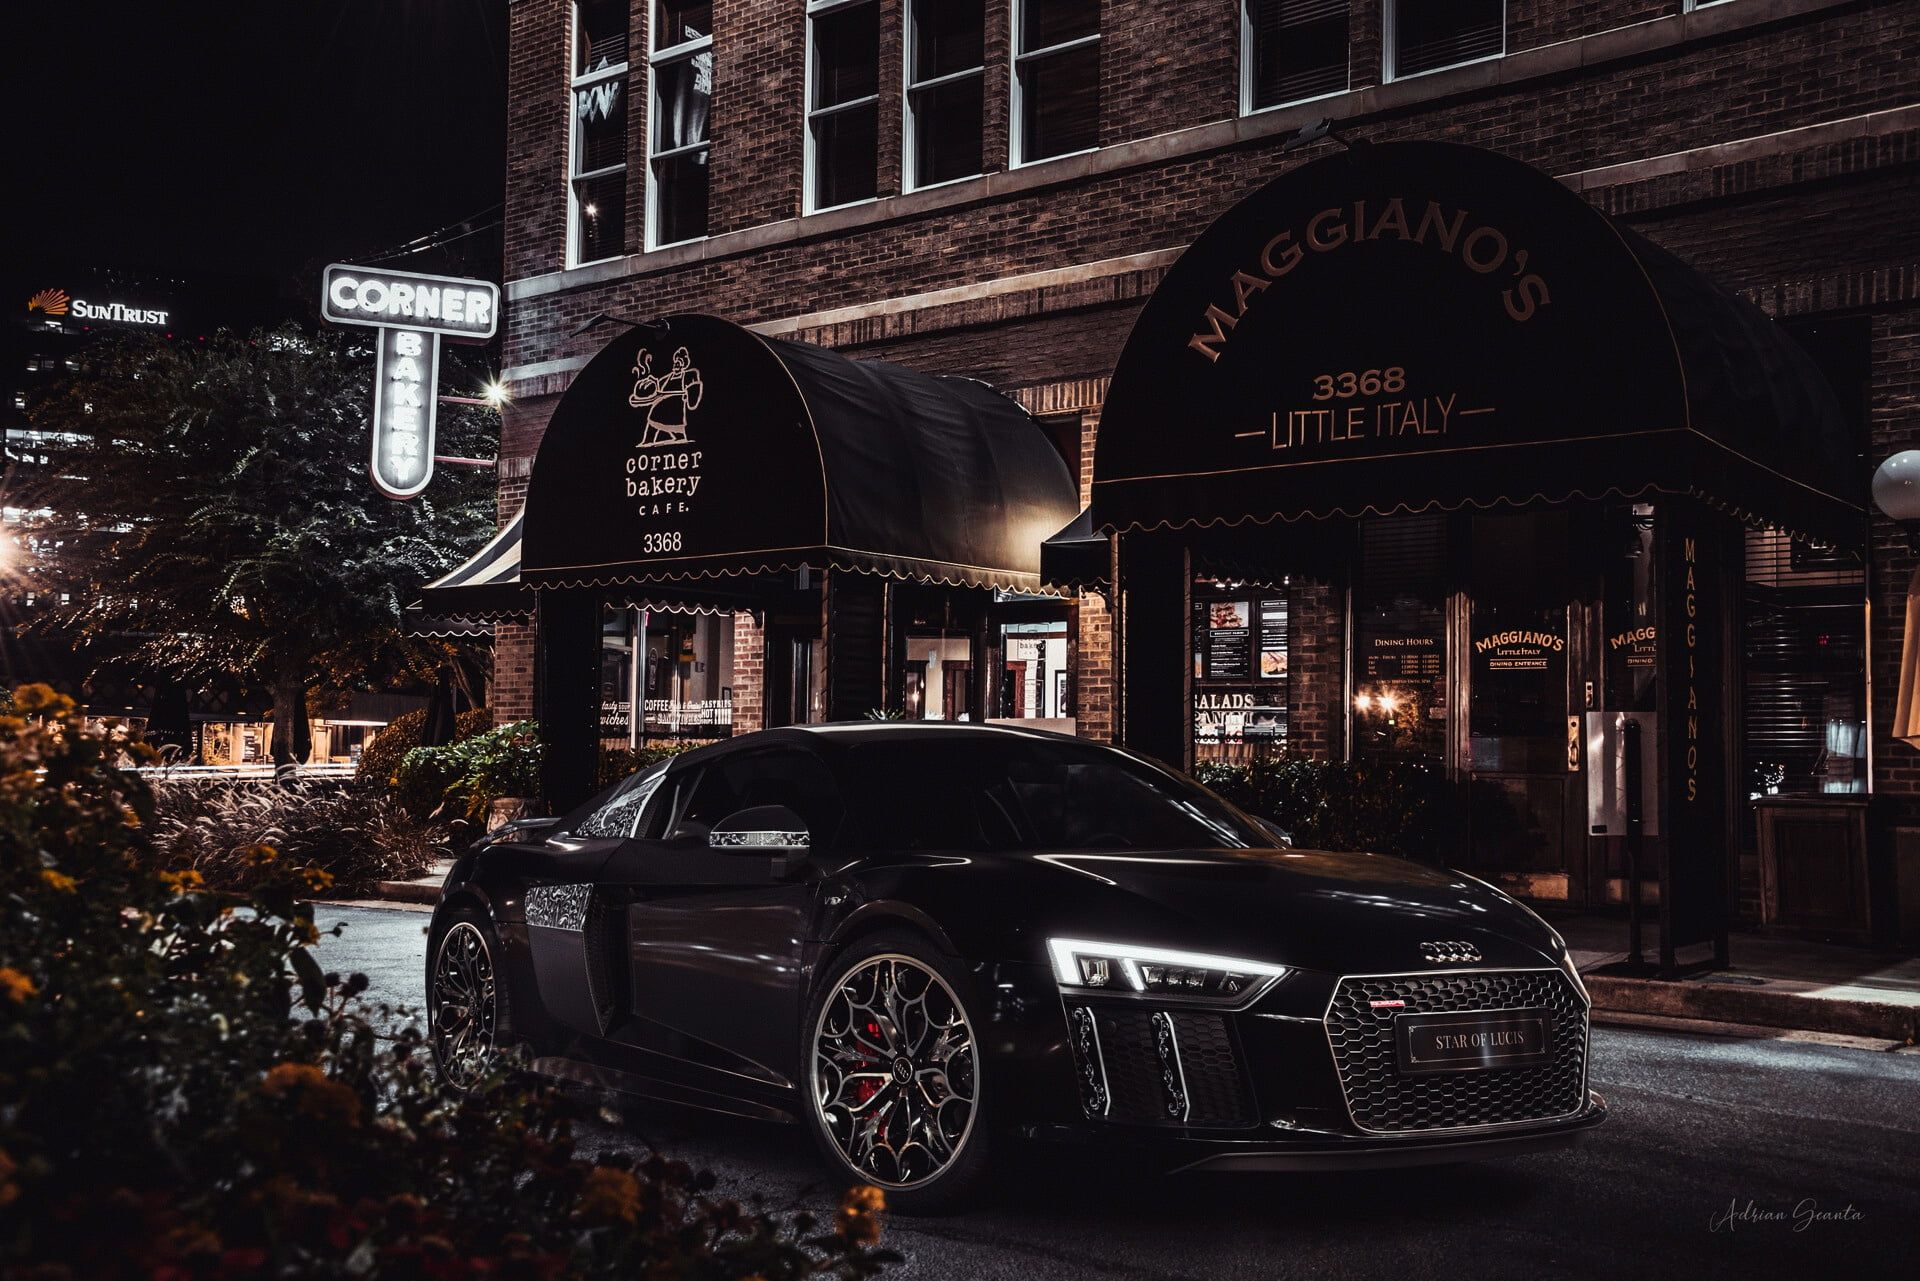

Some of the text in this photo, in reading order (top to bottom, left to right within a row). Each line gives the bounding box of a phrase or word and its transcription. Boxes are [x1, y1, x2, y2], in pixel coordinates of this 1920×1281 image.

[1187, 197, 1552, 364] MAGGIANO'S
[330, 276, 492, 324] CORNER
[1312, 367, 1406, 400] 3368
[391, 331, 423, 481] BAKERY
[1272, 393, 1457, 450] LITTLE ITALY
[626, 451, 702, 474] corner
[625, 476, 701, 497] bakery
[643, 531, 682, 553] 3368
[1375, 638, 1434, 647] DINING HOURS
[1475, 630, 1565, 653] MAGGIANO'S
[1684, 537, 1698, 801] MAGGIANO'S
[644, 700, 669, 711] COFFEE
[701, 709, 714, 718] HOT
[1436, 1030, 1525, 1050] STAR OF LUCIS
